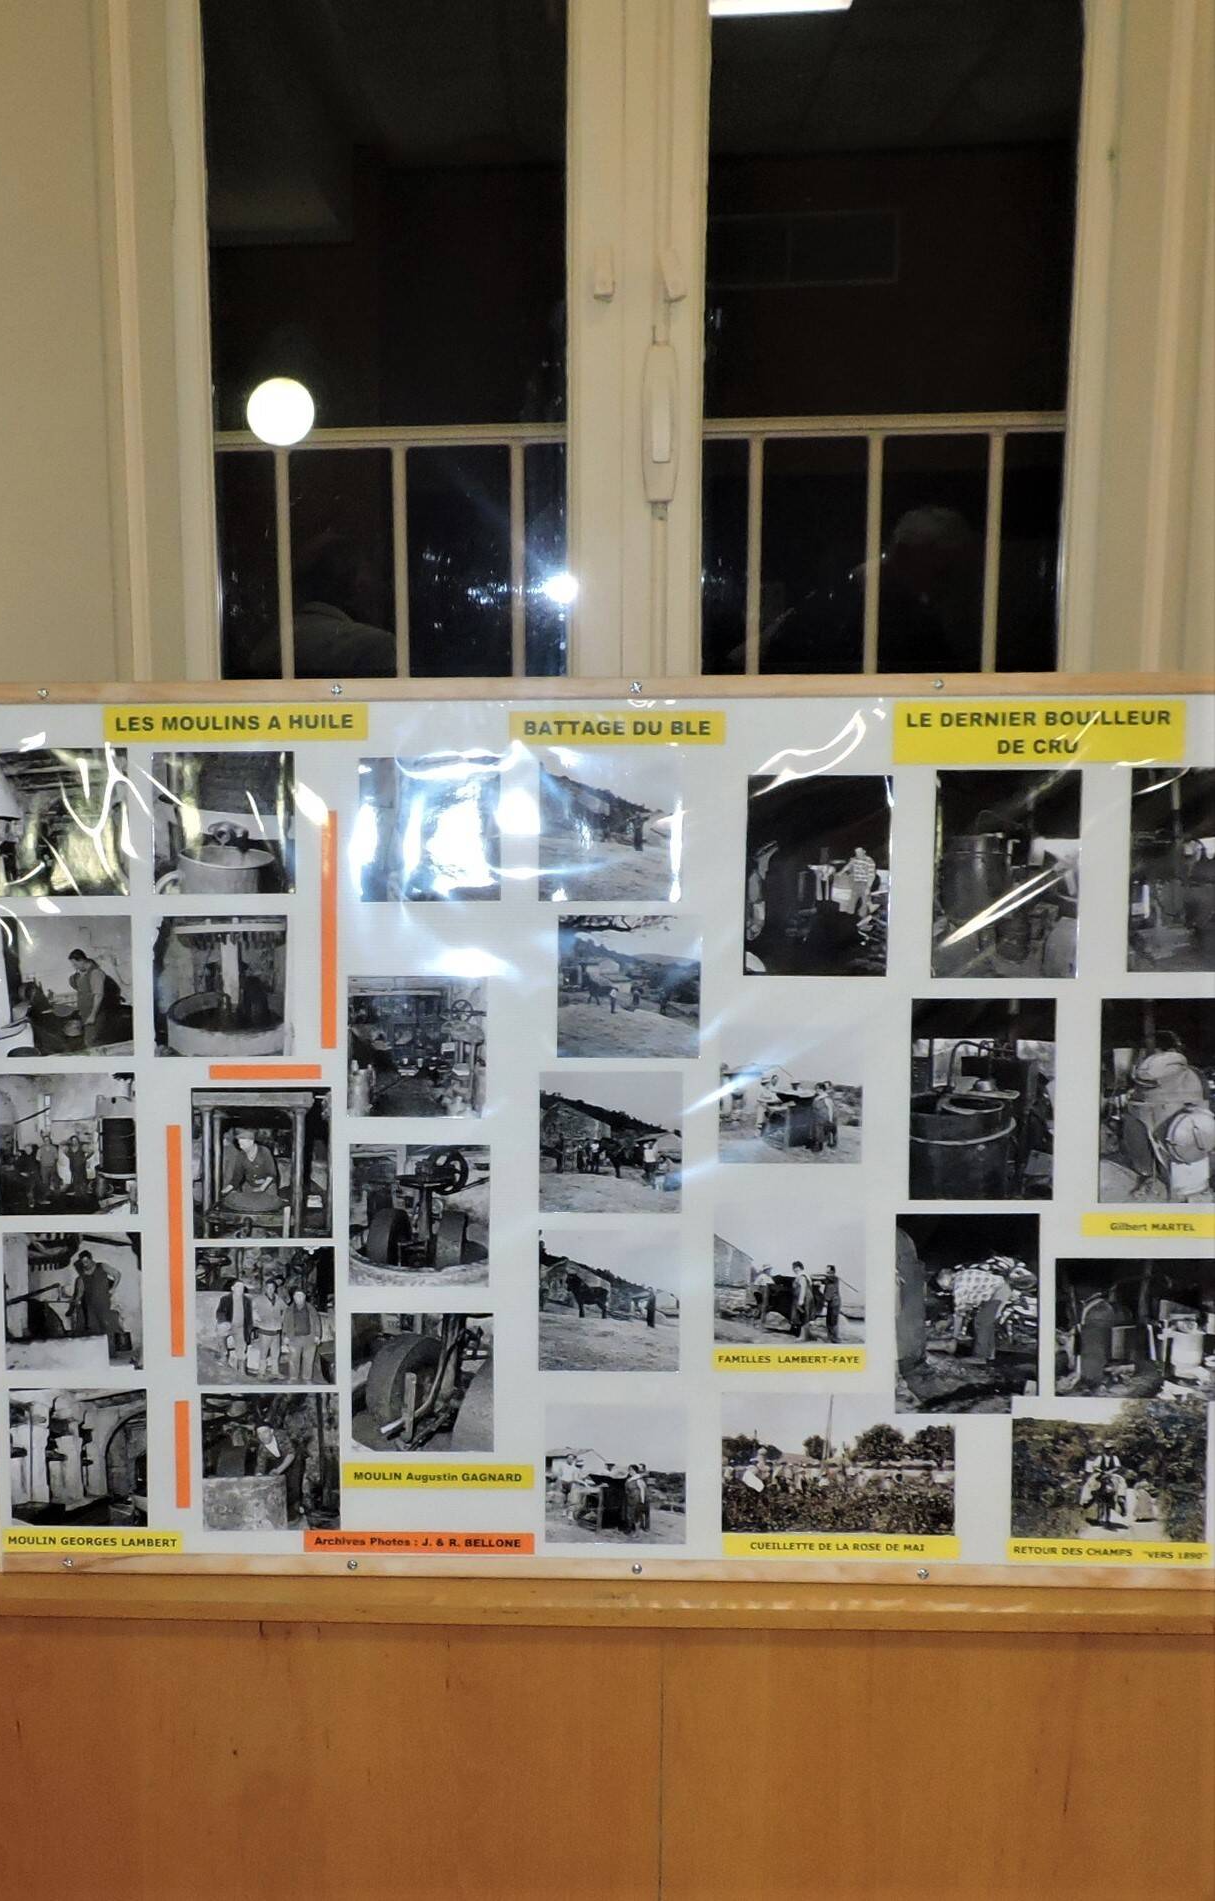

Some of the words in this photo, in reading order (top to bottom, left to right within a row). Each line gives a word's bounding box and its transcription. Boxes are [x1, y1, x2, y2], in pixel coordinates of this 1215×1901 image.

[115, 716, 154, 732] LES
[161, 715, 259, 731] MOULINS
[268, 715, 281, 730] A
[288, 714, 354, 729] HUILE
[906, 712, 932, 728] LE
[940, 711, 1036, 727] DERNIER
[523, 720, 625, 736] BATTAGE
[633, 721, 662, 736] DU
[670, 721, 711, 736] BLE
[997, 739, 1024, 754] DE
[1033, 739, 1079, 754] CRU
[1110, 1222, 1147, 1231] Gilbert
[1151, 1223, 1195, 1231] MARTEL
[718, 1355, 771, 1363] FAMILLES
[778, 1356, 859, 1364] LAMBERT-FAYE
[354, 1472, 402, 1481] MOULIN
[406, 1472, 458, 1483] Augustin
[462, 1473, 522, 1482] GAGNARD
[8, 1536, 56, 1545] MOULIN
[61, 1537, 117, 1546] GEORGES
[121, 1538, 177, 1547] LAMBERT
[314, 1536, 366, 1546] Archives
[370, 1537, 410, 1547] Photos
[422, 1538, 431, 1547] J.
[436, 1538, 444, 1547] &
[449, 1538, 459, 1547] R.
[465, 1538, 521, 1548] BELLONE
[750, 1542, 814, 1551] CUEILLETTE
[819, 1542, 832, 1551] DE
[836, 1543, 849, 1551] LA
[853, 1543, 881, 1551] ROSE
[886, 1543, 899, 1551] DE
[903, 1544, 925, 1552] MAI
[1013, 1546, 1057, 1555] RETOUR
[1061, 1548, 1083, 1556] DES
[1086, 1548, 1132, 1557] CHAMPS
